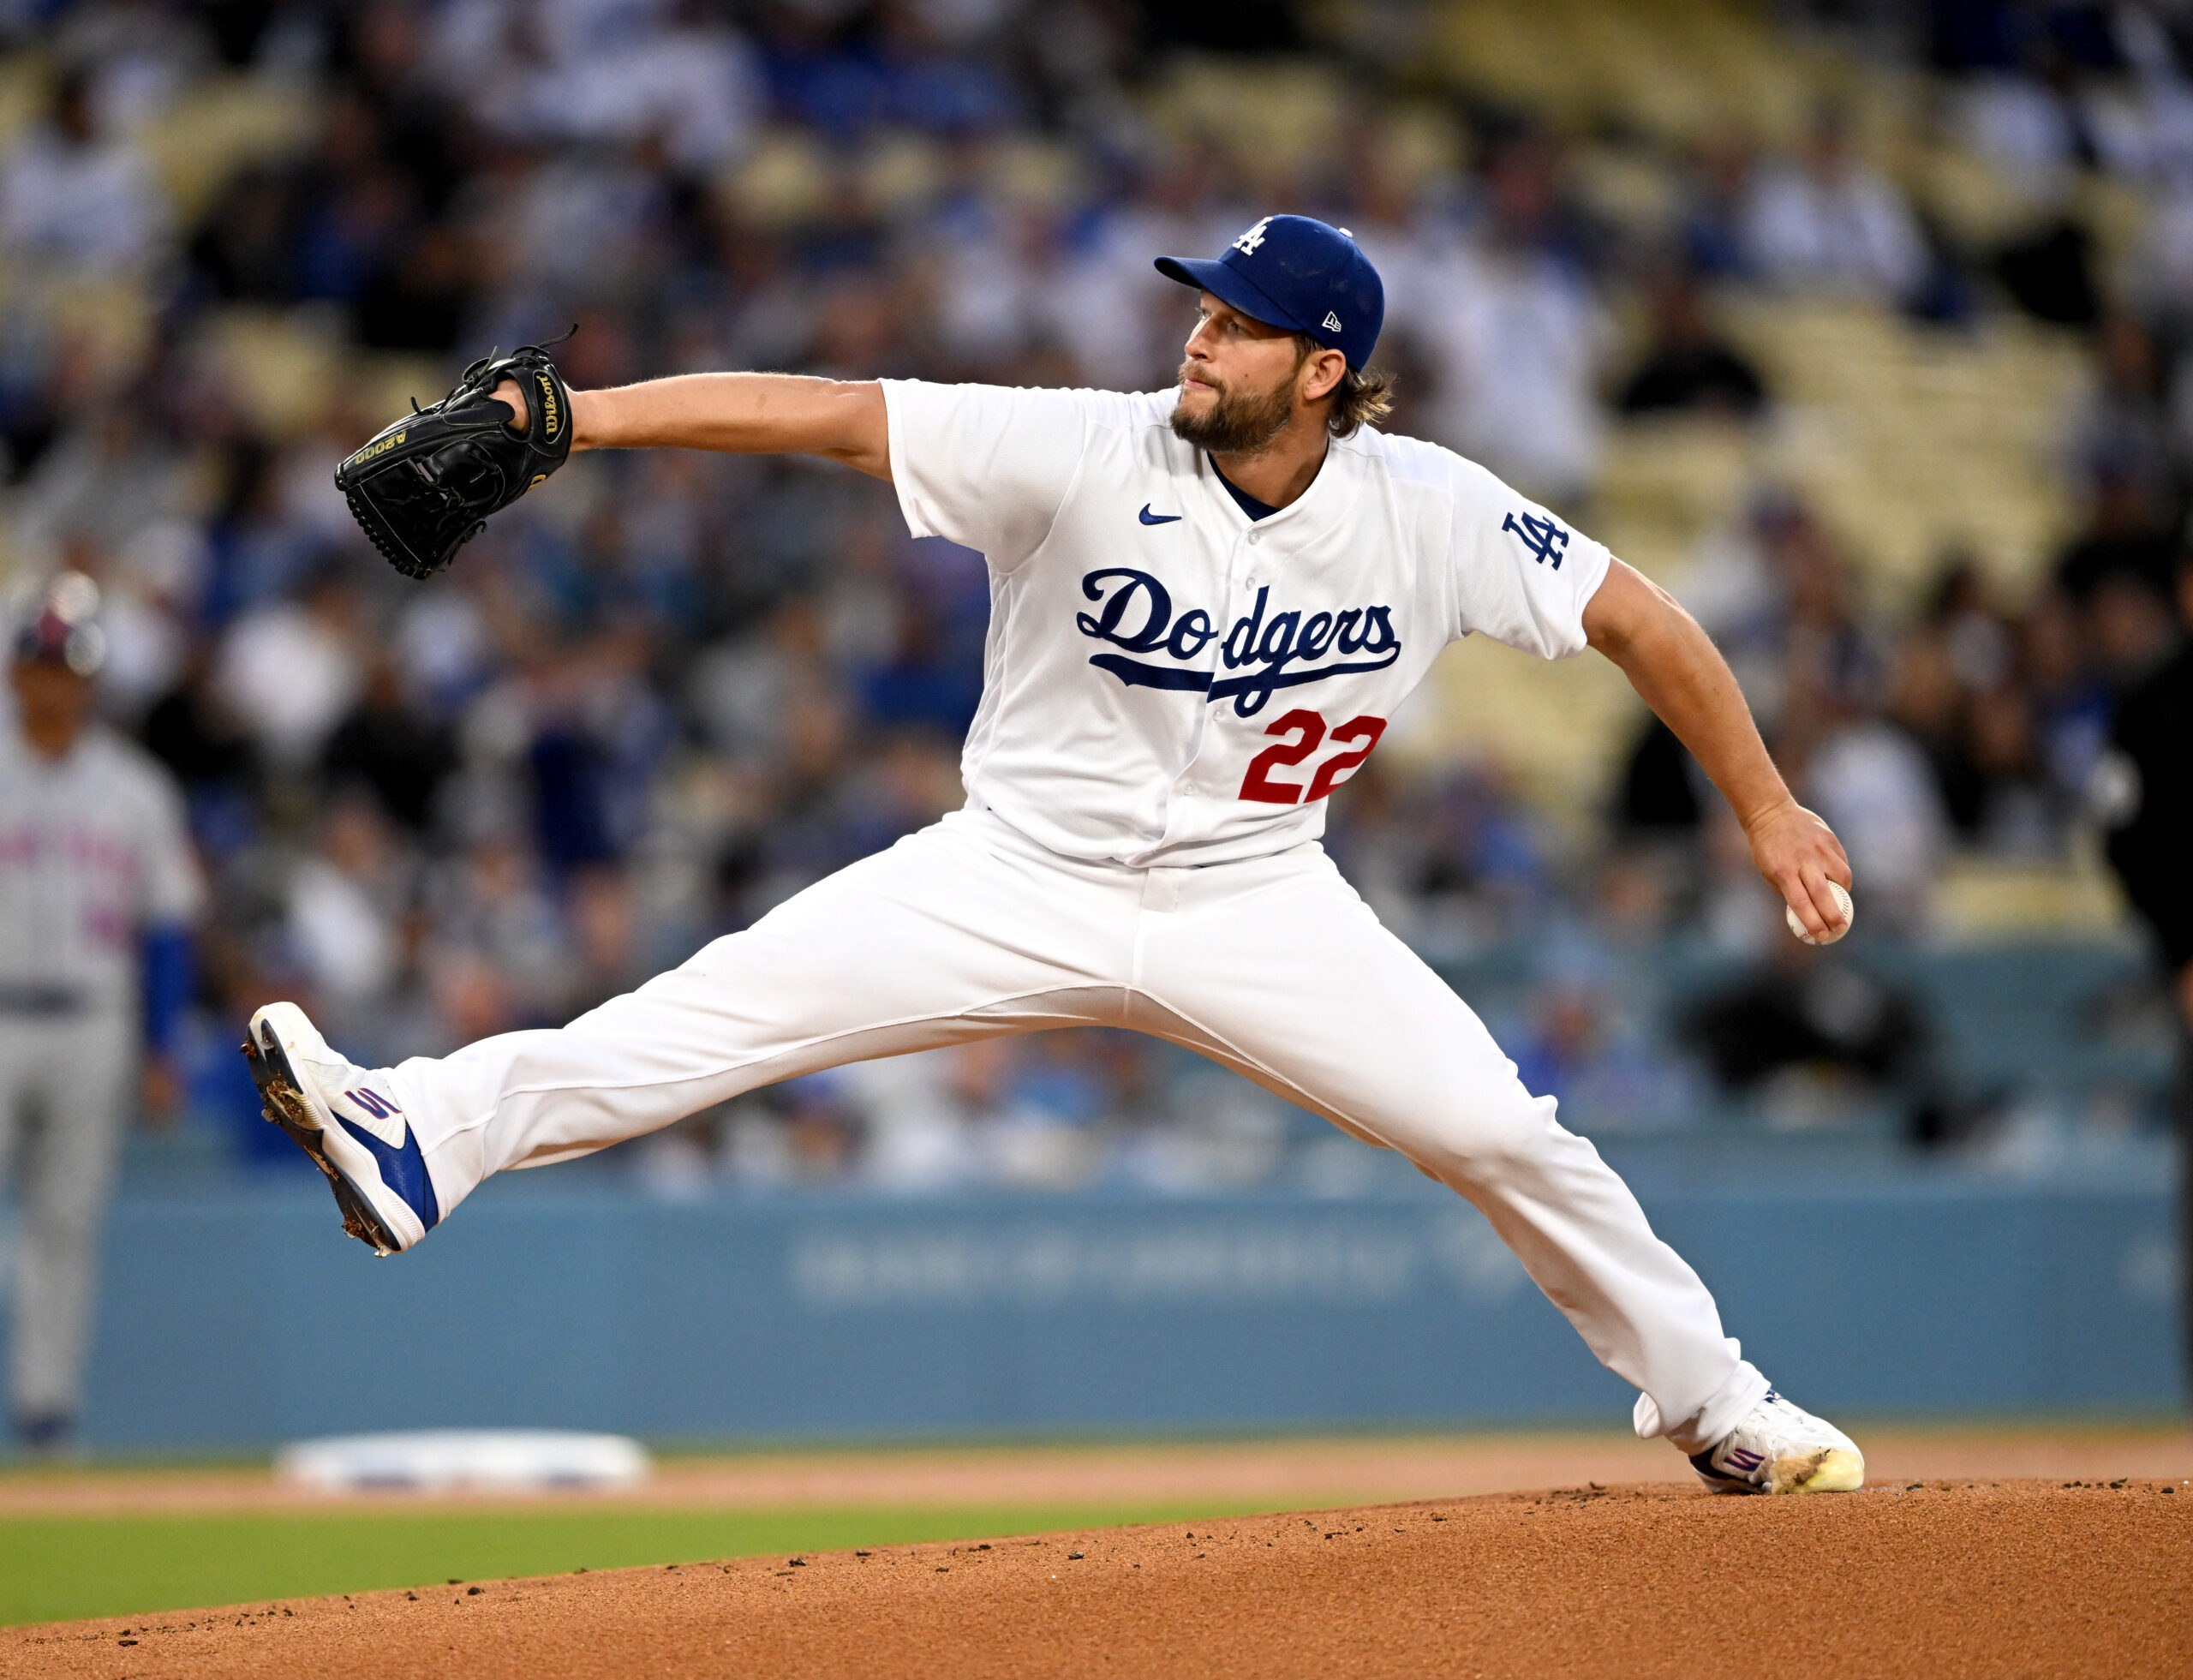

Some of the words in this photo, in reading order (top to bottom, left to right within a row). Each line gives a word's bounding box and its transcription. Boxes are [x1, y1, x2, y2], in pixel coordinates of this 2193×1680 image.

[1232, 217, 1274, 256] LA
[535, 374, 558, 435] Wilson
[355, 430, 407, 464] A2000
[1501, 511, 1569, 570] LA
[1076, 567, 1401, 718] Dodgers
[1239, 709, 1388, 804] 22
